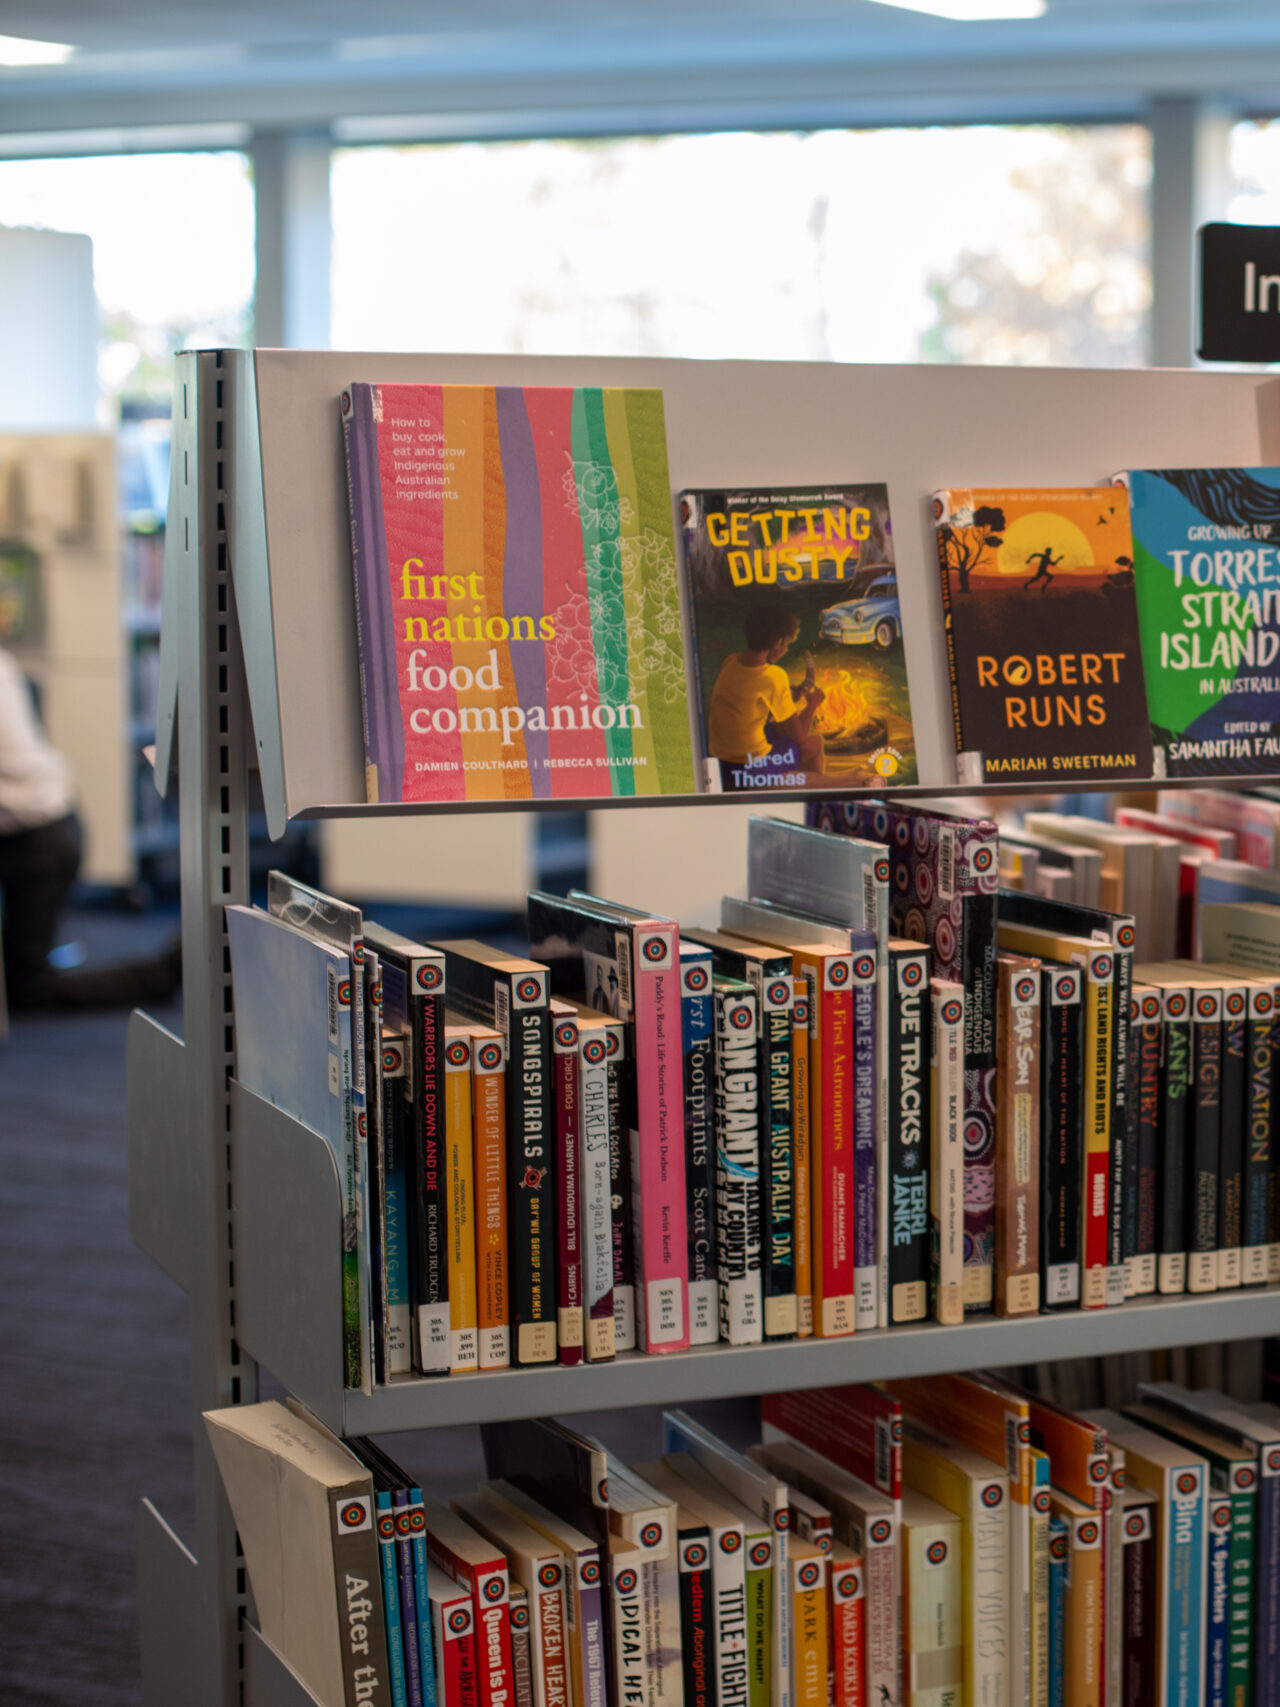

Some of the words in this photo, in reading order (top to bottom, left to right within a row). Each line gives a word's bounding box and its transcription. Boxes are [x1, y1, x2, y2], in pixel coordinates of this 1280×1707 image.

[391, 418, 416, 427] How
[418, 418, 431, 428] to
[392, 431, 416, 443] buy,
[418, 432, 449, 443] cook,
[393, 447, 411, 456] eat
[414, 446, 435, 456] and
[438, 447, 466, 458] grow
[394, 460, 456, 472] Indigenous
[395, 474, 451, 485] Australian
[706, 507, 871, 547] GETTING
[1187, 525, 1250, 542] GROWING
[1252, 524, 1271, 539] UP
[400, 558, 484, 601] first
[727, 545, 854, 587] DUSTY
[403, 606, 556, 643] nations
[406, 648, 503, 692] food
[976, 653, 1125, 687] ROBERT
[1200, 680, 1214, 695] IN
[409, 693, 646, 745] companion
[1005, 694, 1106, 728] RUNS
[1224, 722, 1253, 735] EDITED
[1256, 722, 1271, 734] BY
[415, 760, 459, 772] DAMIEN
[462, 758, 528, 771] COULTHARD
[542, 757, 593, 769] REBECCA
[595, 755, 648, 768] SULLIVAN
[744, 748, 795, 770] Jared
[881, 758, 892, 773] 2
[986, 756, 1047, 773] MARIAH
[1052, 754, 1136, 769] SWEETMAN
[1169, 739, 1251, 760] SAMANTHA
[731, 770, 806, 787] Thomas
[983, 945, 993, 1017] MACQUARIE
[1119, 954, 1130, 987] LWAYS
[652, 975, 665, 1012] Paddy's
[901, 985, 920, 1034] RUE
[1118, 989, 1129, 1016] WAS,
[424, 1004, 436, 1073] WARRIORS
[654, 1013, 666, 1041] Road:
[770, 1009, 789, 1042] TAN
[831, 1009, 847, 1047] First
[855, 984, 871, 1062] PEOPLE'S
[963, 992, 973, 1056] AUSTRALIA
[981, 1018, 991, 1054] ATLAS
[1097, 1007, 1107, 1035] LAND
[1117, 1018, 1128, 1060] ALWAYS
[656, 1043, 667, 1062] Life
[1096, 1037, 1107, 1077] RIGHTS
[424, 1075, 436, 1093] LIE
[523, 1014, 544, 1158] SONGSPIRALS
[657, 1064, 668, 1096] Stories
[770, 1050, 790, 1110] GRANT
[901, 1036, 921, 1146] TRACKS
[1096, 1078, 1106, 1101] AND
[1116, 1063, 1127, 1090] WILL
[1140, 1022, 1159, 1128] OUNTRY
[425, 1096, 437, 1137] DOWN
[484, 1076, 497, 1122] WONDER
[585, 1080, 607, 1152] CHARLES
[658, 1098, 668, 1107] of
[832, 1051, 848, 1151] Astronomers
[856, 1065, 872, 1150] DREAMING
[1115, 1092, 1126, 1107] BE
[485, 1125, 498, 1140] OF
[659, 1110, 669, 1145] Patrick
[1095, 1102, 1106, 1135] RIOTS
[425, 1139, 437, 1168] AND
[486, 1143, 499, 1181] LITTLE
[660, 1148, 670, 1182] Dodson
[426, 1170, 438, 1191] DIE
[771, 1123, 791, 1223] AUSTRALIA
[836, 1172, 846, 1200] DUANE
[486, 1185, 501, 1229] THINGS
[727, 1179, 746, 1204] MY
[910, 1169, 928, 1235] TERRI
[1092, 1172, 1106, 1217] MORRIS
[427, 1203, 438, 1250] RICHARD
[661, 1205, 671, 1232] Kevin
[693, 1187, 710, 1233] Scott
[746, 1180, 761, 1248] TALKING
[892, 1173, 912, 1247] JANKE
[727, 1207, 748, 1280] COUNTRY
[771, 1232, 792, 1267] DAY
[836, 1201, 846, 1262] HAMACHER
[493, 1248, 503, 1280] VINCE
[530, 1236, 541, 1269] GROUP
[747, 1250, 761, 1271] TO
[428, 1253, 440, 1303] TRUDGEN
[531, 1271, 541, 1284] OF
[494, 1282, 504, 1321] COPLEY
[531, 1286, 542, 1319] WOMEN
[430, 1334, 447, 1343] TRU
[489, 1350, 507, 1359] COP
[1176, 1499, 1198, 1544] Bina
[978, 1509, 1006, 1575] MANY
[1211, 1549, 1229, 1624] Sparklers
[345, 1574, 375, 1655] After
[541, 1591, 563, 1658] BROKEN
[586, 1620, 599, 1642] The
[718, 1583, 746, 1643] TITLE
[803, 1590, 818, 1643] DARK
[978, 1589, 1007, 1660] VOICES
[482, 1608, 504, 1669] Queen
[587, 1642, 601, 1669] 1967
[352, 1664, 381, 1707] the
[489, 1669, 506, 1689] is
[589, 1670, 603, 1707] Refere
[720, 1650, 748, 1707] FIGHT
[805, 1649, 820, 1700] emu
